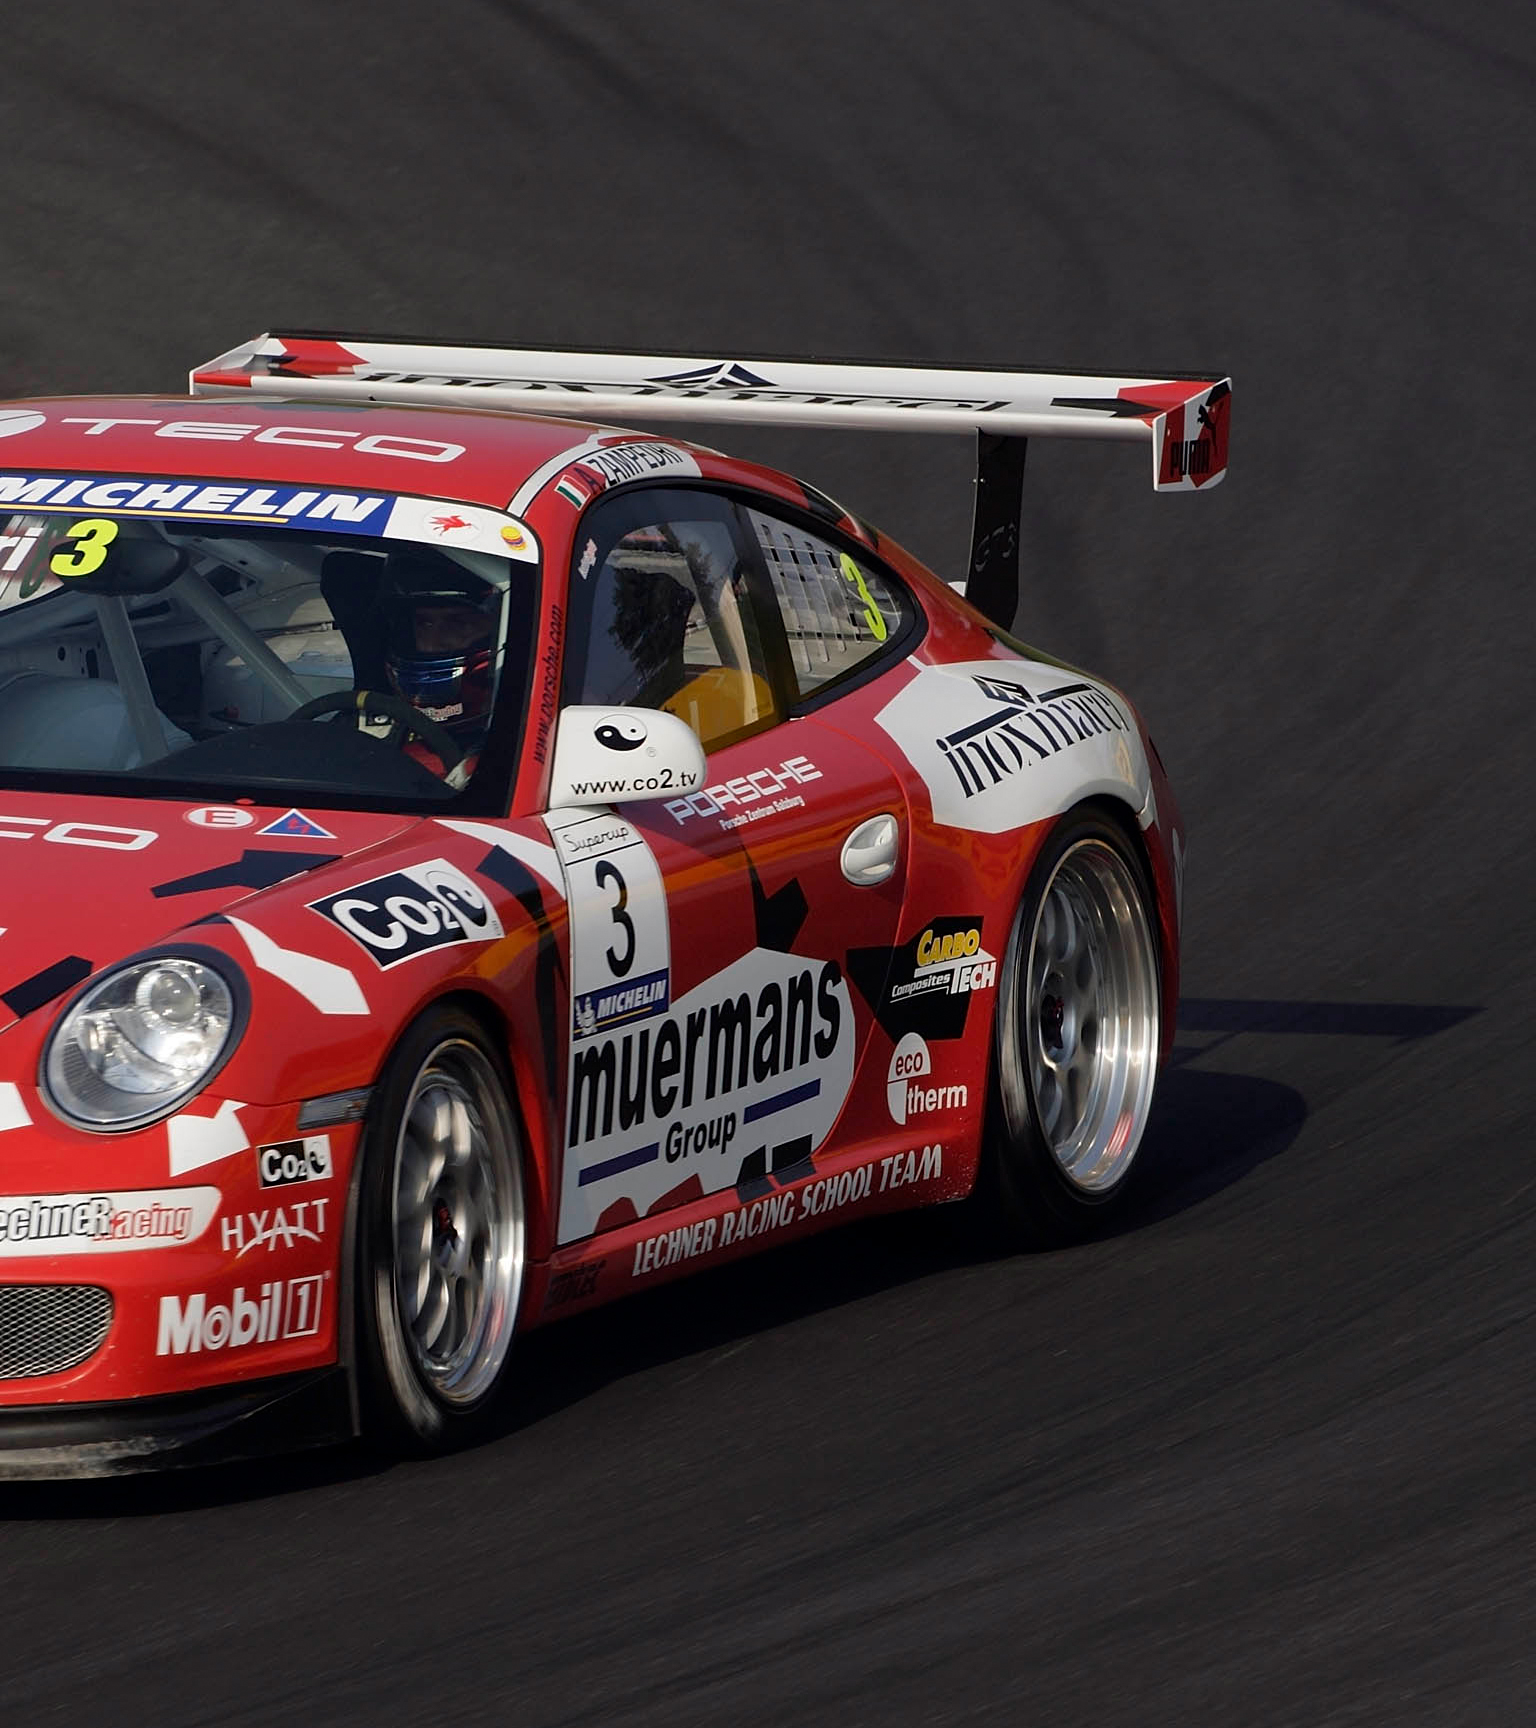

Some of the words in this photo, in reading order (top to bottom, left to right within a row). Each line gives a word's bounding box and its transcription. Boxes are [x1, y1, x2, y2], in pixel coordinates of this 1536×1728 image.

[62, 417, 466, 463] TECO
[1170, 438, 1212, 478] PUMA
[587, 443, 684, 486] ZAMPEDRI
[49, 518, 119, 577] 3
[839, 552, 887, 641] 3
[533, 604, 563, 765] www.porsche.com
[571, 768, 698, 796] www.co2.tv
[663, 756, 824, 826] PORSCHE
[563, 826, 630, 853] Supercup
[718, 814, 749, 831] Porsche
[745, 804, 777, 822] Zentrum
[594, 859, 636, 979] 3
[917, 928, 981, 967] CARBO
[596, 978, 668, 1019] MICHELIN
[891, 972, 951, 998] Composites
[950, 961, 997, 995] TECH
[568, 959, 842, 1149] muermans
[895, 1051, 923, 1077] eco
[907, 1084, 968, 1116] therm
[665, 1111, 737, 1164] Group
[220, 1198, 330, 1254] HYATT
[632, 1217, 717, 1278] LECHNER
[718, 1190, 796, 1249] RACING
[798, 1162, 873, 1220] SCHOOL
[879, 1143, 943, 1193] TEAM
[156, 1281, 282, 1357] Mobil
